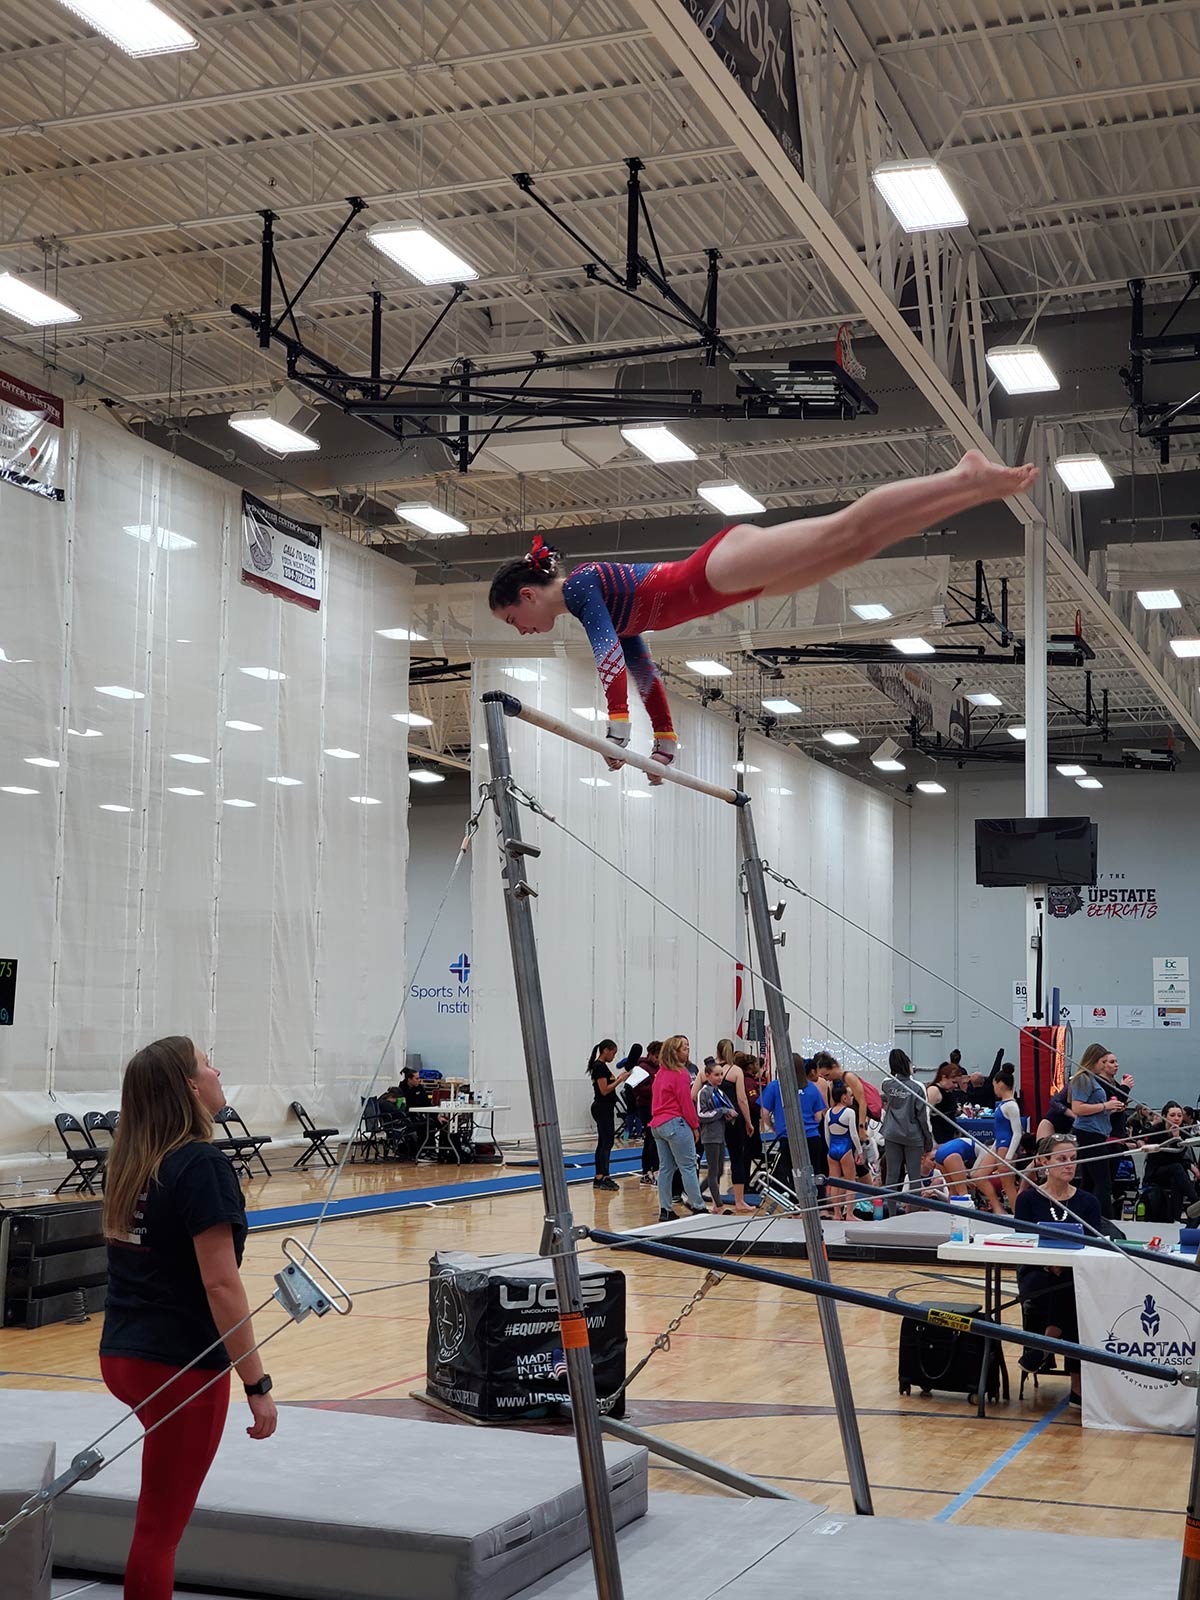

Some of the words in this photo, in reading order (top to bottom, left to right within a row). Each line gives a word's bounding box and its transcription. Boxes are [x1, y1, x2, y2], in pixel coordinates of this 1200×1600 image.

[0, 378, 26, 399] ENTER
[1088, 888, 1156, 903] UPSTATE
[1087, 902, 1159, 920] BEARCATS
[411, 985, 453, 999] Sports
[504, 1321, 561, 1337] #EQUIPPE
[1105, 1341, 1196, 1357] SPARTAN
[516, 1352, 552, 1366] MADE
[1151, 1357, 1193, 1366] CLASSIC
[517, 1366, 530, 1374] IN
[532, 1363, 553, 1373] THE
